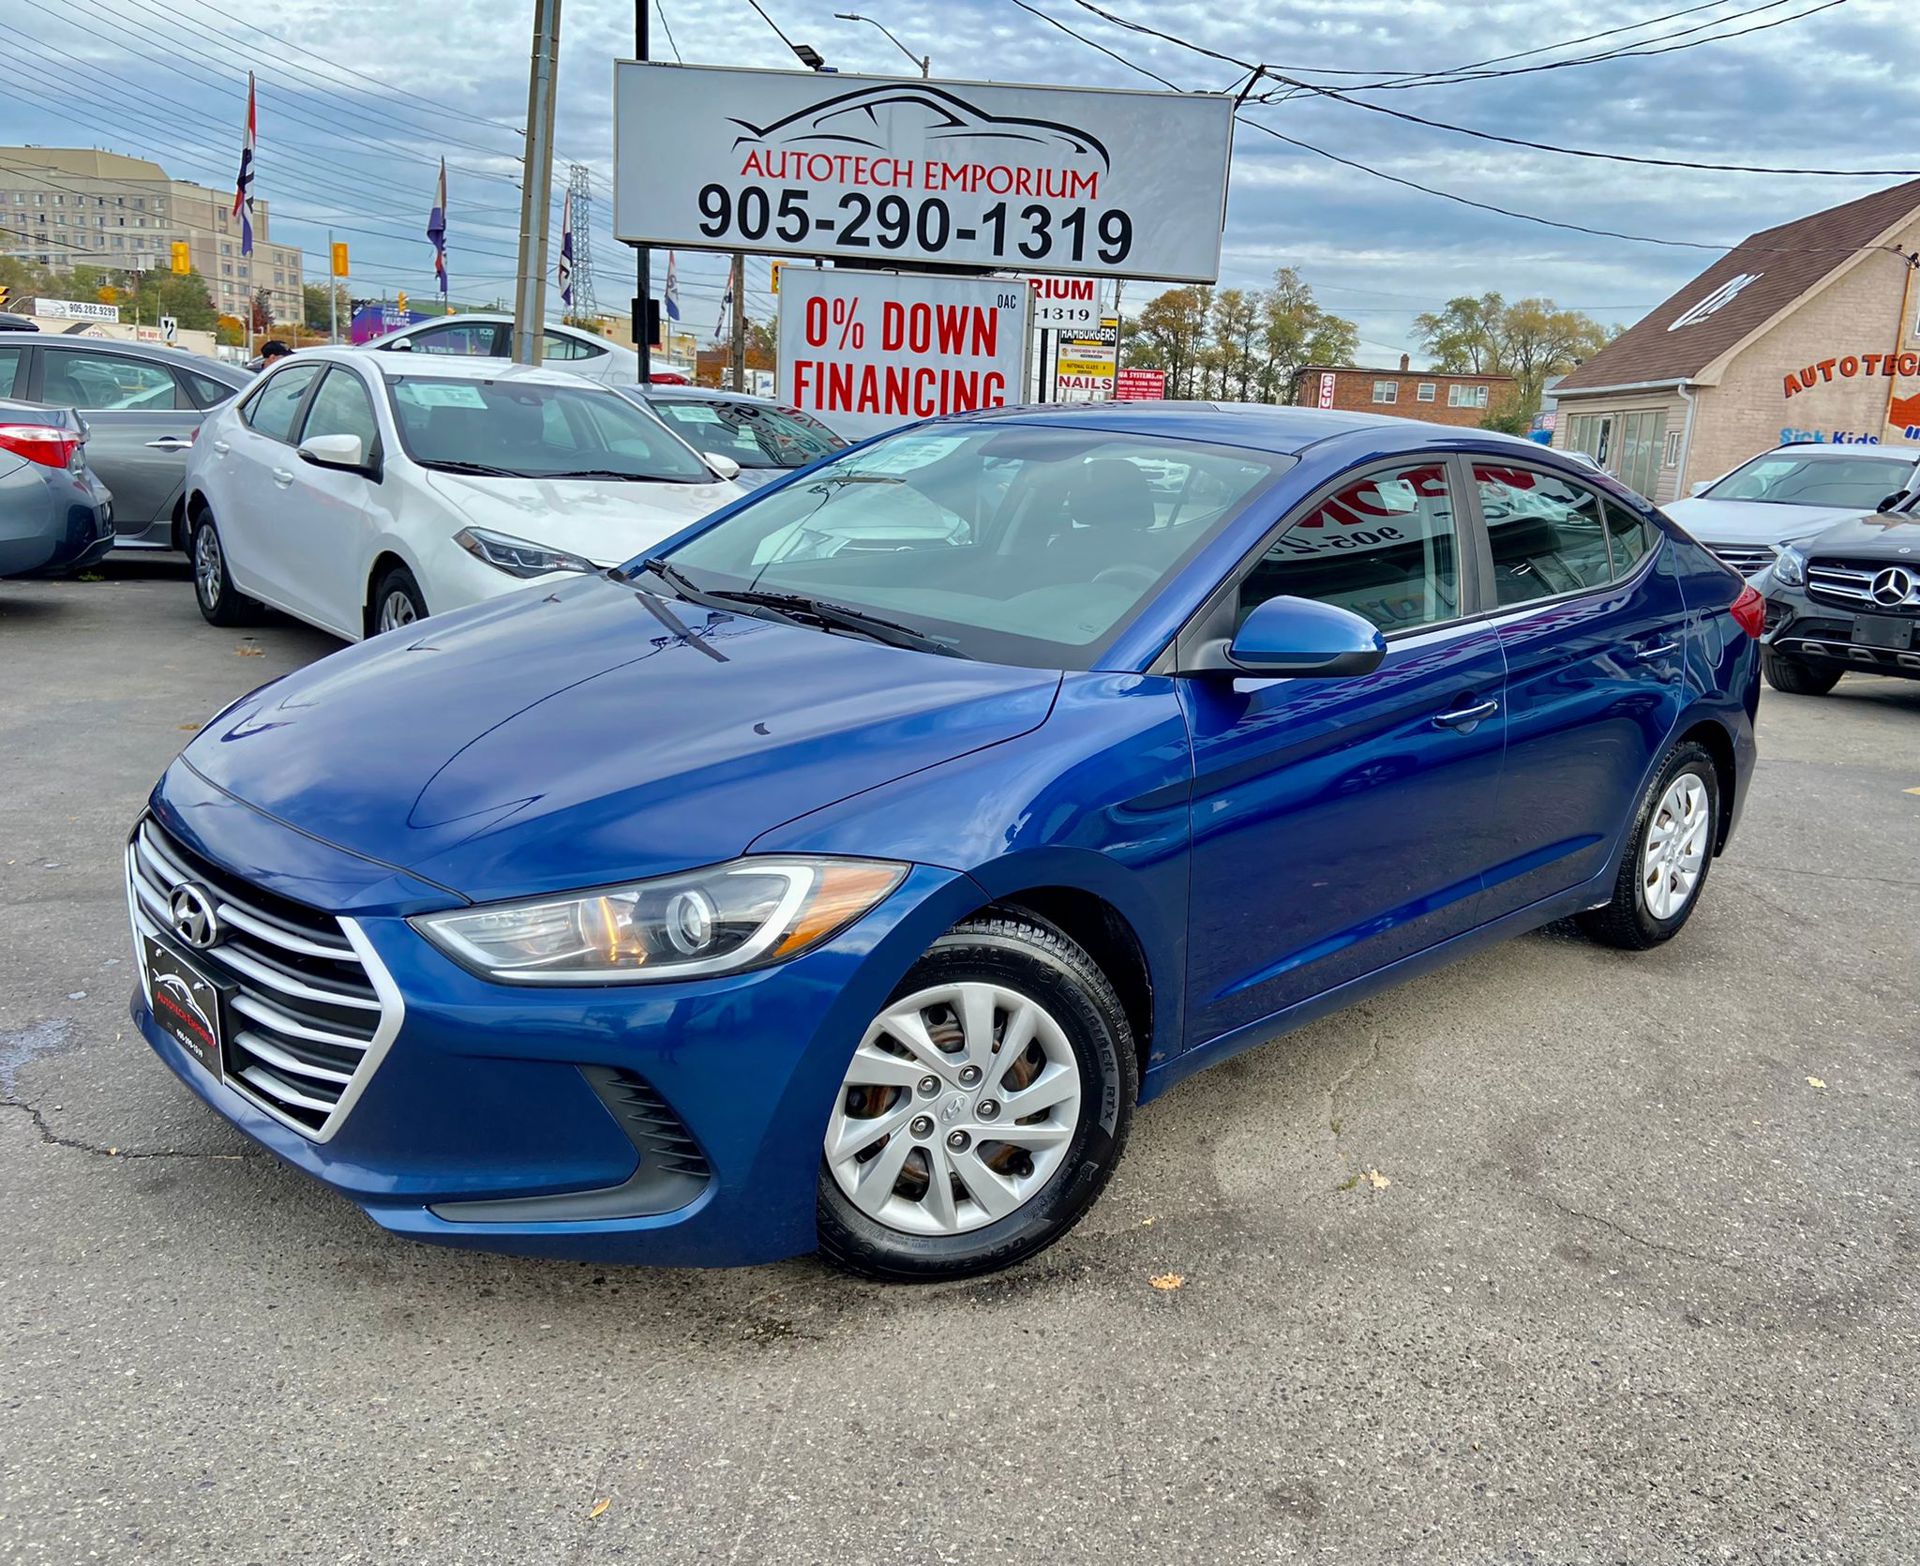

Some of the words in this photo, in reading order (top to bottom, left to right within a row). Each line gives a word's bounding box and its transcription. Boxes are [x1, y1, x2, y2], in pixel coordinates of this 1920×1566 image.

[741, 149, 914, 189] AUTOTECH
[923, 161, 1099, 200] EMPORIUM
[698, 183, 1133, 265] 905-290-1319
[997, 293, 1017, 309] OAC
[806, 296, 865, 351] 0%
[882, 301, 998, 358] DOWN
[1060, 328, 1116, 341] HAMBURGERS
[794, 360, 1005, 417] FINANCING
[1058, 375, 1113, 391] NAILS
[1832, 431, 1880, 445] Kids
[1101, 1085, 1116, 1120] RTX
